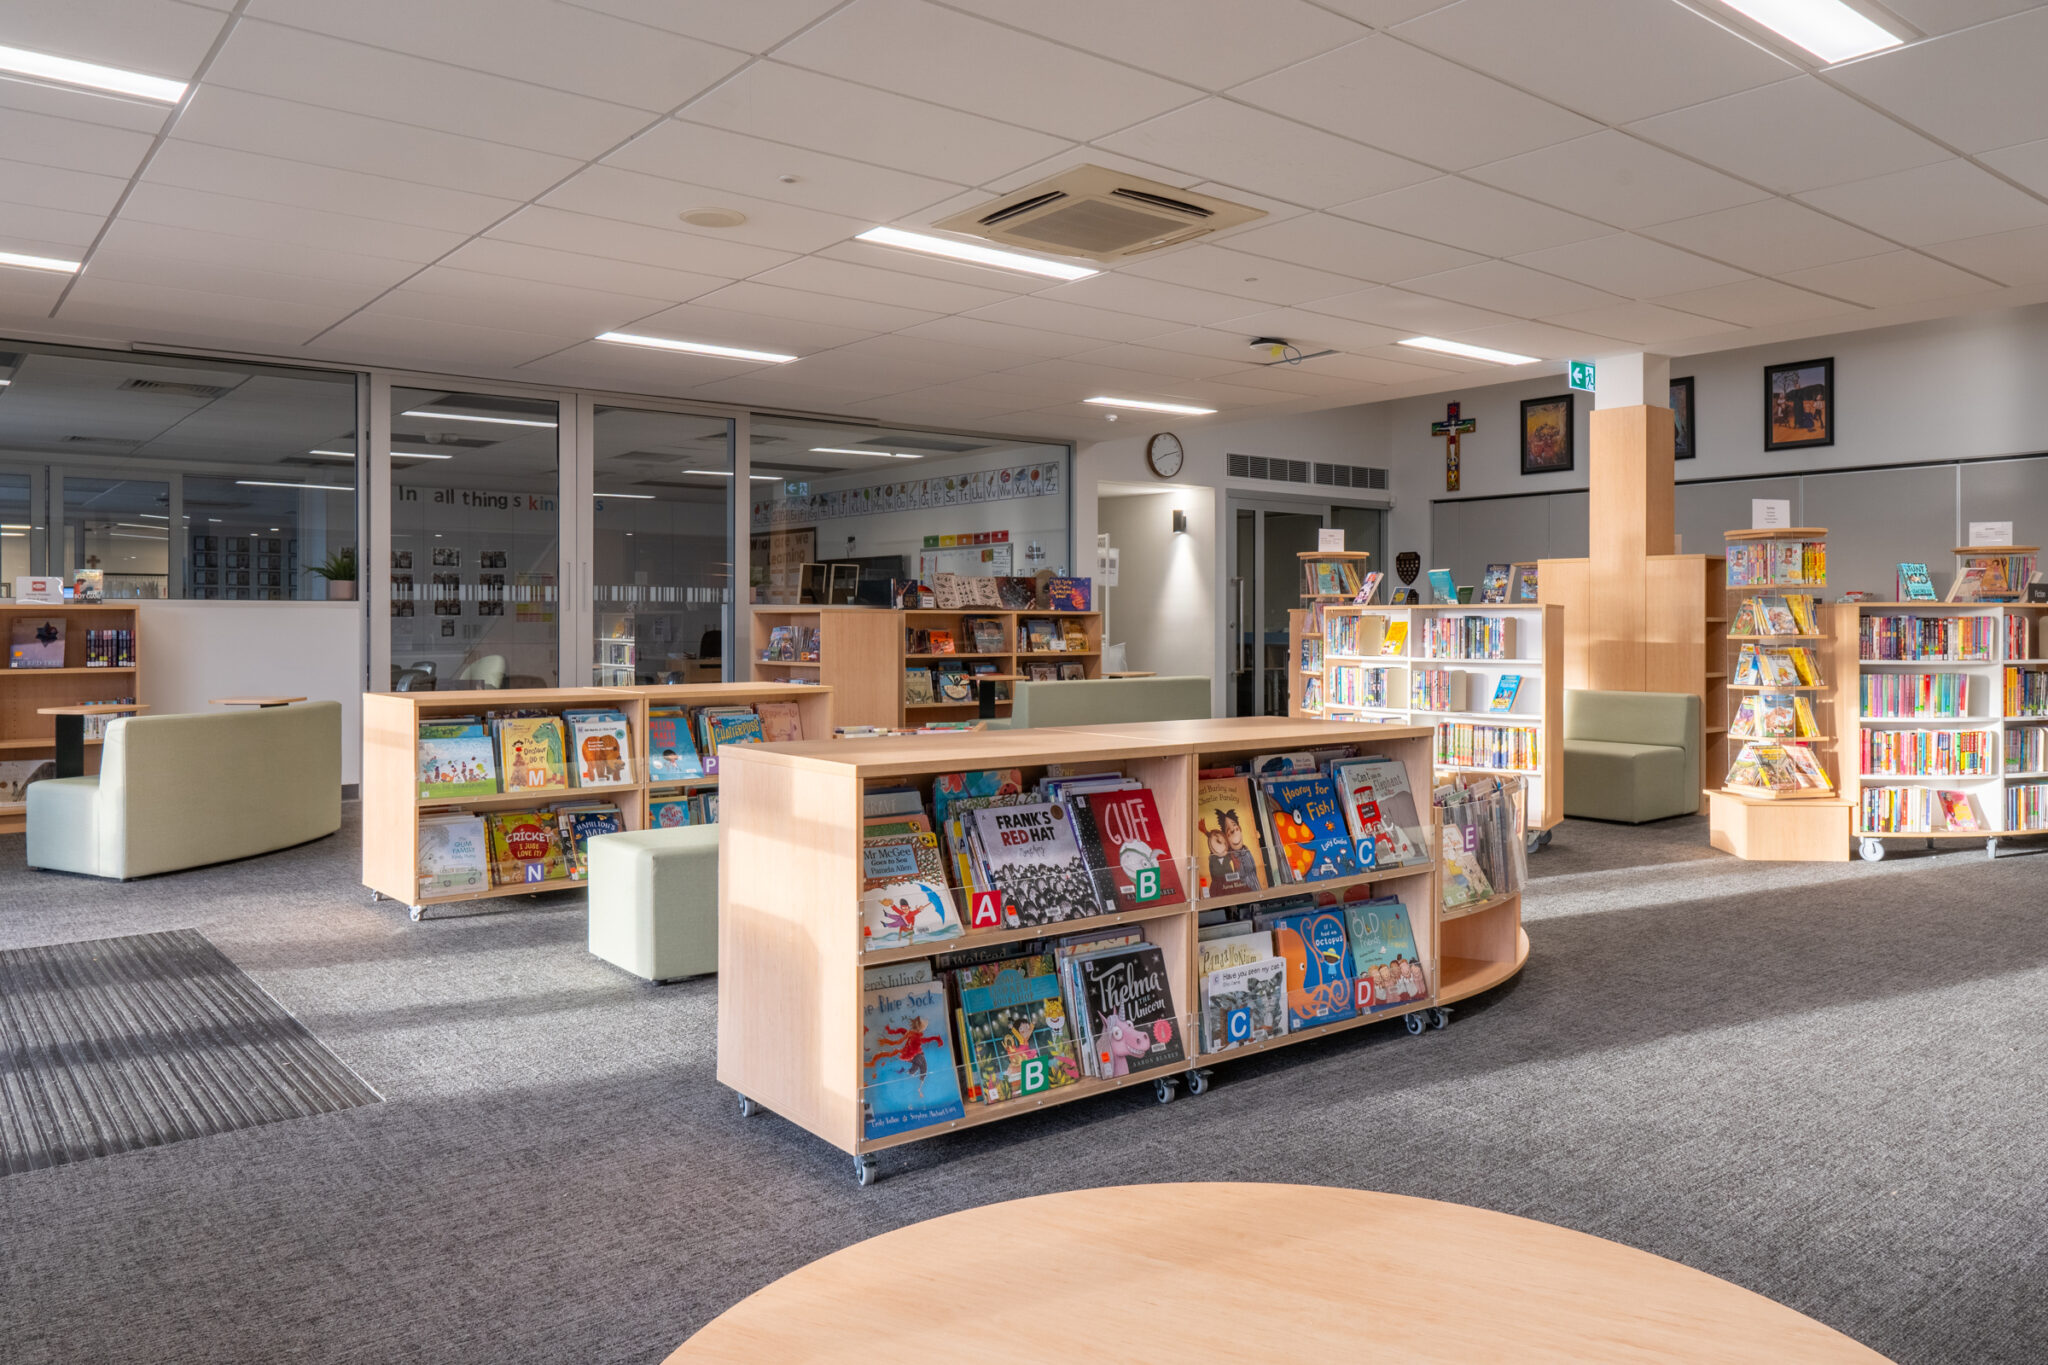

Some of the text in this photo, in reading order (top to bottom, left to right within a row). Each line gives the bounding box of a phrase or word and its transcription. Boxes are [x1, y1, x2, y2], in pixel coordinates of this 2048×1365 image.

[399, 485, 417, 501] In
[434, 489, 455, 505] all
[462, 491, 521, 510] things
[795, 533, 809, 545] we
[705, 758, 717, 773] P
[528, 769, 545, 787] M
[1373, 774, 1403, 792] Elephant
[1281, 781, 1329, 804] Hooray for
[996, 811, 1052, 830] FRANK'S
[1104, 798, 1151, 845] CUFF
[1306, 799, 1336, 821] Fish!
[505, 830, 551, 844] CRICKET
[1001, 827, 1056, 847] RED HAT
[1465, 826, 1475, 849] E
[864, 846, 911, 860] Mr McGee
[1358, 840, 1373, 865] C
[527, 864, 542, 882] N
[896, 864, 913, 872] Allen
[1140, 871, 1157, 899] B
[975, 893, 998, 926] A
[1352, 912, 1380, 938] OLD
[1223, 973, 1237, 981] Have
[1238, 971, 1248, 980] you
[1248, 966, 1261, 976] seen
[1262, 965, 1270, 974] my
[1090, 961, 1163, 1013] Thelma
[1357, 980, 1372, 1005] D
[878, 994, 902, 1014] Blue
[907, 988, 935, 1008] Sock
[1128, 998, 1166, 1022] Unicorn
[1139, 994, 1151, 1005] THE
[1230, 1011, 1247, 1038] C
[1024, 1059, 1046, 1091] B
